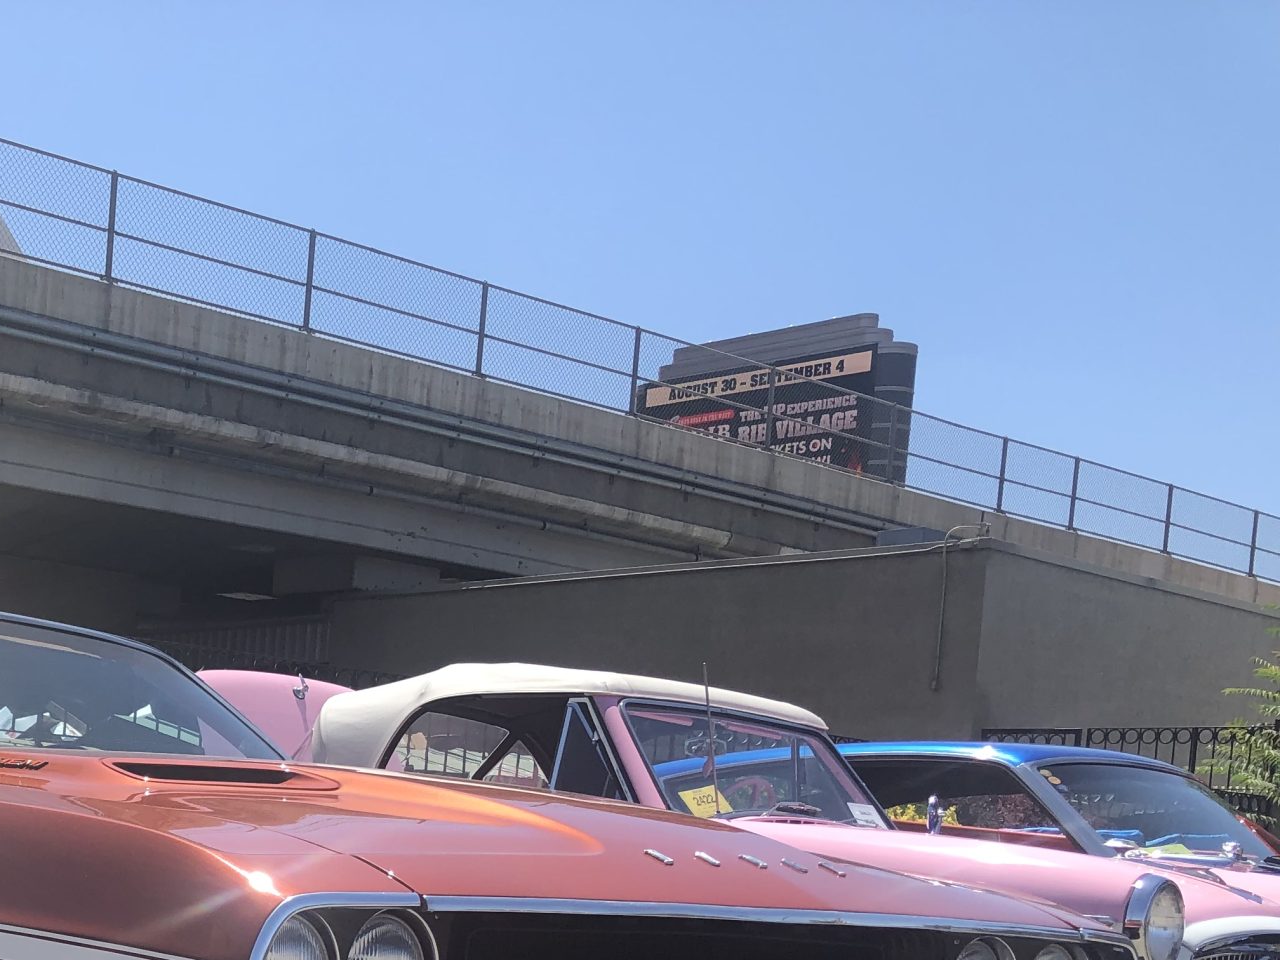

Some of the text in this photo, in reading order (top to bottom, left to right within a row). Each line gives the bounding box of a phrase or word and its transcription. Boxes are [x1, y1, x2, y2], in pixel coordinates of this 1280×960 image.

[669, 381, 718, 400] AUGUST
[721, 378, 737, 393] 30
[835, 359, 846, 373] 4
[786, 394, 858, 415] EXPERIENCE
[775, 409, 858, 439] VILLAGE
[810, 437, 833, 453] ON
